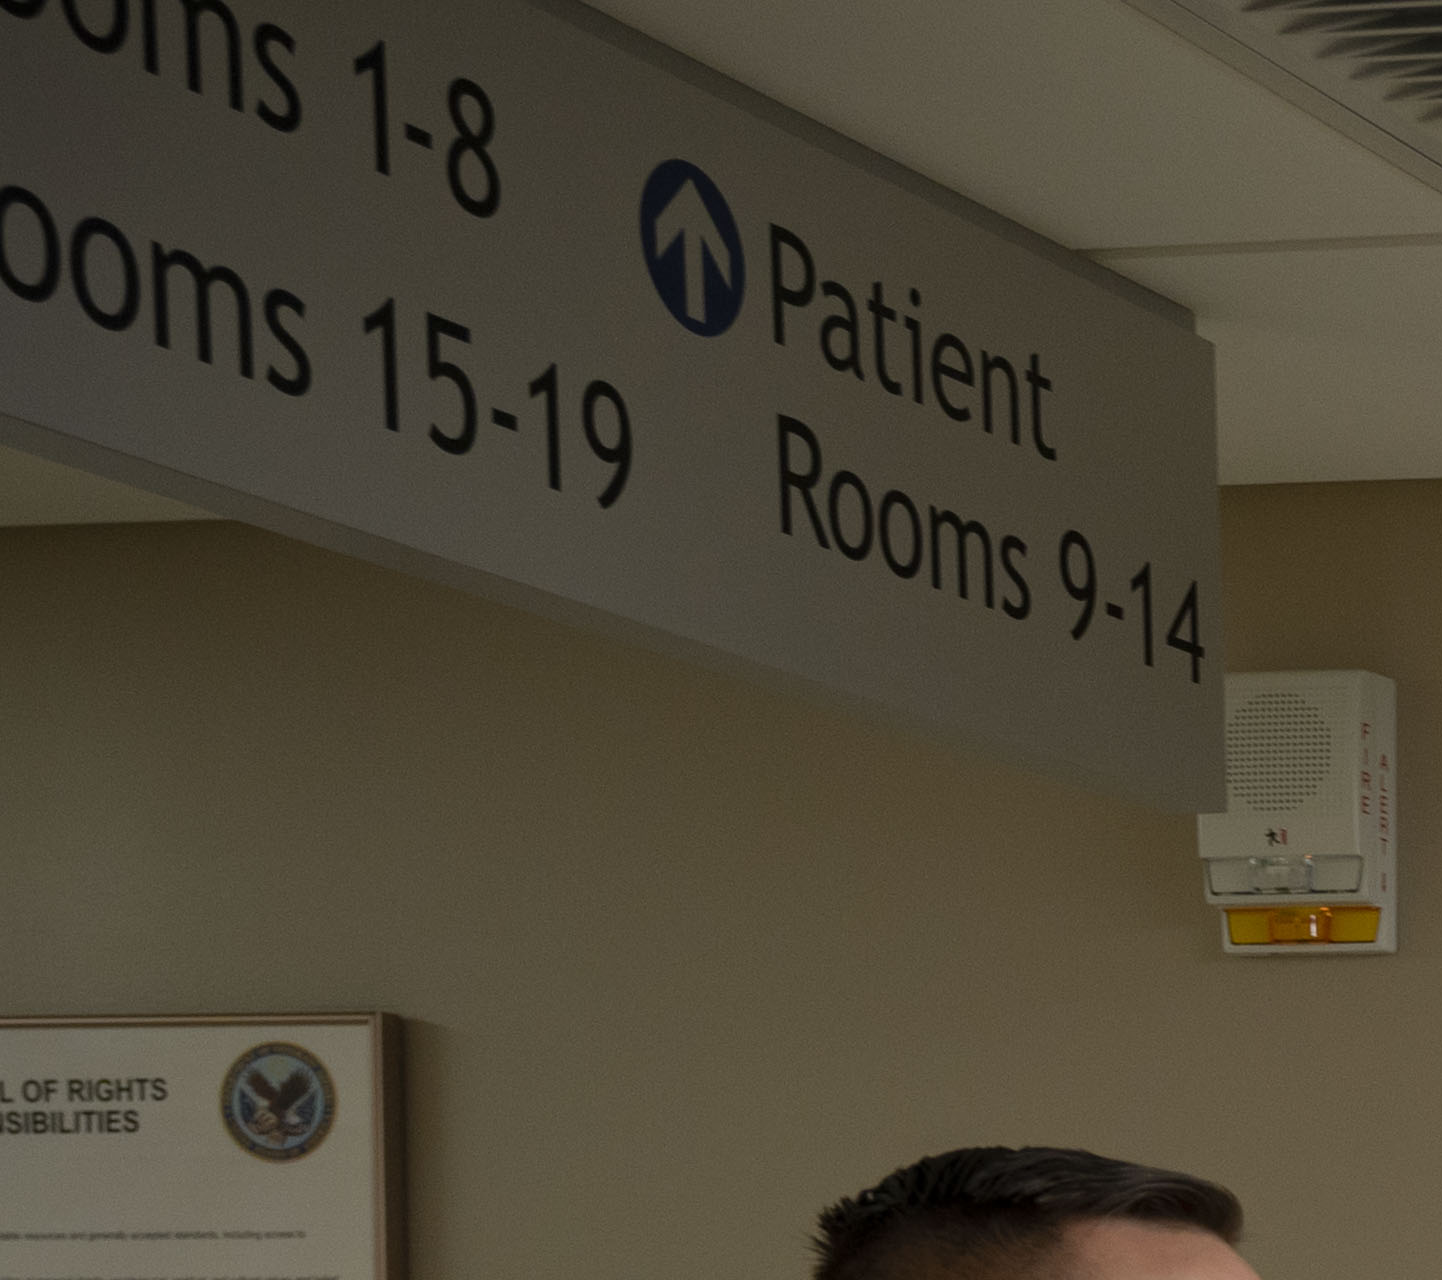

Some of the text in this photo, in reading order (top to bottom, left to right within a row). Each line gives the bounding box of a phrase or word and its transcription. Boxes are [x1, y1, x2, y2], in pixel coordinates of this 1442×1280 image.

[0, 0, 500, 219] ms 1-8
[364, 297, 632, 510] 15-19
[770, 223, 1057, 461] Patient
[777, 412, 1205, 685] Rooms 9-14
[0, 1110, 140, 1135] SIBILITIES
[22, 1080, 58, 1103] OF
[67, 1078, 169, 1103] RIGHTS
